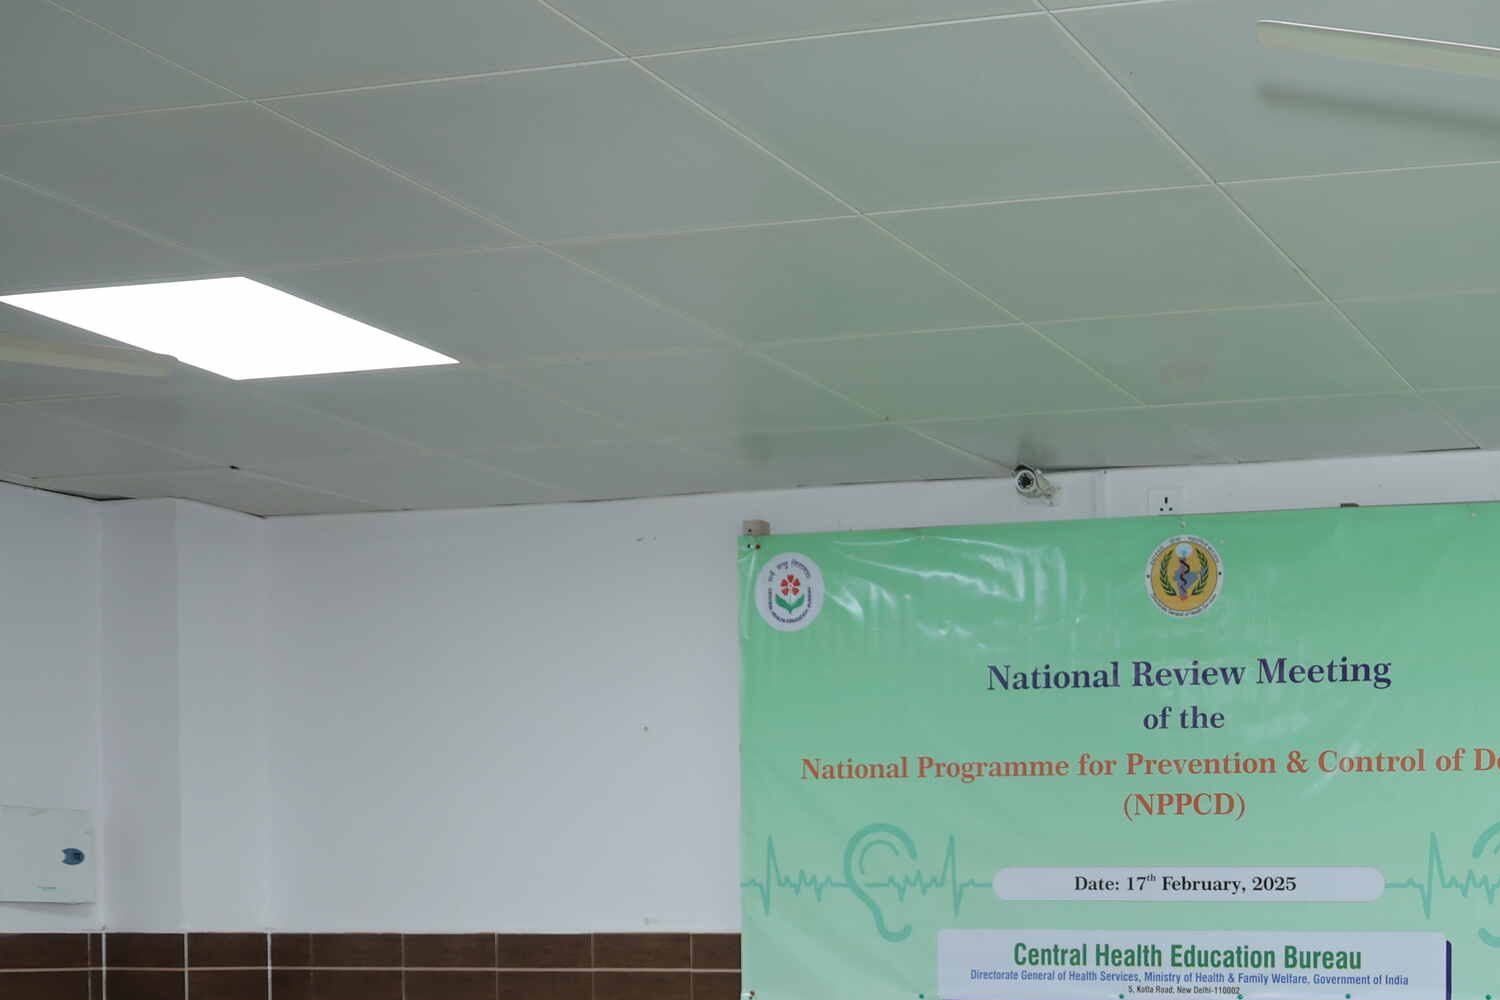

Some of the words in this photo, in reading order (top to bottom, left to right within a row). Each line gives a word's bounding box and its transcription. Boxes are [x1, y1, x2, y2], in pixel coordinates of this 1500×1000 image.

[987, 661, 1120, 691] National
[1132, 660, 1247, 688] Review
[1256, 656, 1392, 690] Meeting
[1143, 706, 1172, 730] of
[1179, 705, 1225, 729] the
[800, 757, 909, 780] National
[916, 756, 1070, 784] Programme
[1077, 753, 1118, 776] for
[1125, 752, 1277, 776] Prevention
[1285, 750, 1309, 773] &
[1317, 748, 1426, 773] Control
[1435, 748, 1466, 772] of
[1123, 792, 1247, 821] (NPPCD)
[1074, 875, 1120, 892] Date:
[1161, 875, 1247, 896] February,
[1252, 876, 1297, 892] 2025
[1013, 942, 1087, 966] Central
[1095, 943, 1162, 967] Health
[1170, 944, 1276, 968] Education
[1284, 945, 1362, 969] Bureau
[970, 969, 1018, 980] Directorate
[1021, 970, 1055, 980] General
[1057, 970, 1066, 980] of
[1068, 970, 1097, 981] Health
[1100, 971, 1141, 983] Services,
[1144, 971, 1181, 984] Ministry
[1183, 972, 1193, 982] of
[1195, 972, 1225, 983] Health
[1227, 973, 1235, 983] &
[1238, 973, 1268, 985] Family
[1313, 974, 1371, 985] Government
[1373, 974, 1383, 984] of
[1385, 974, 1409, 985] India
